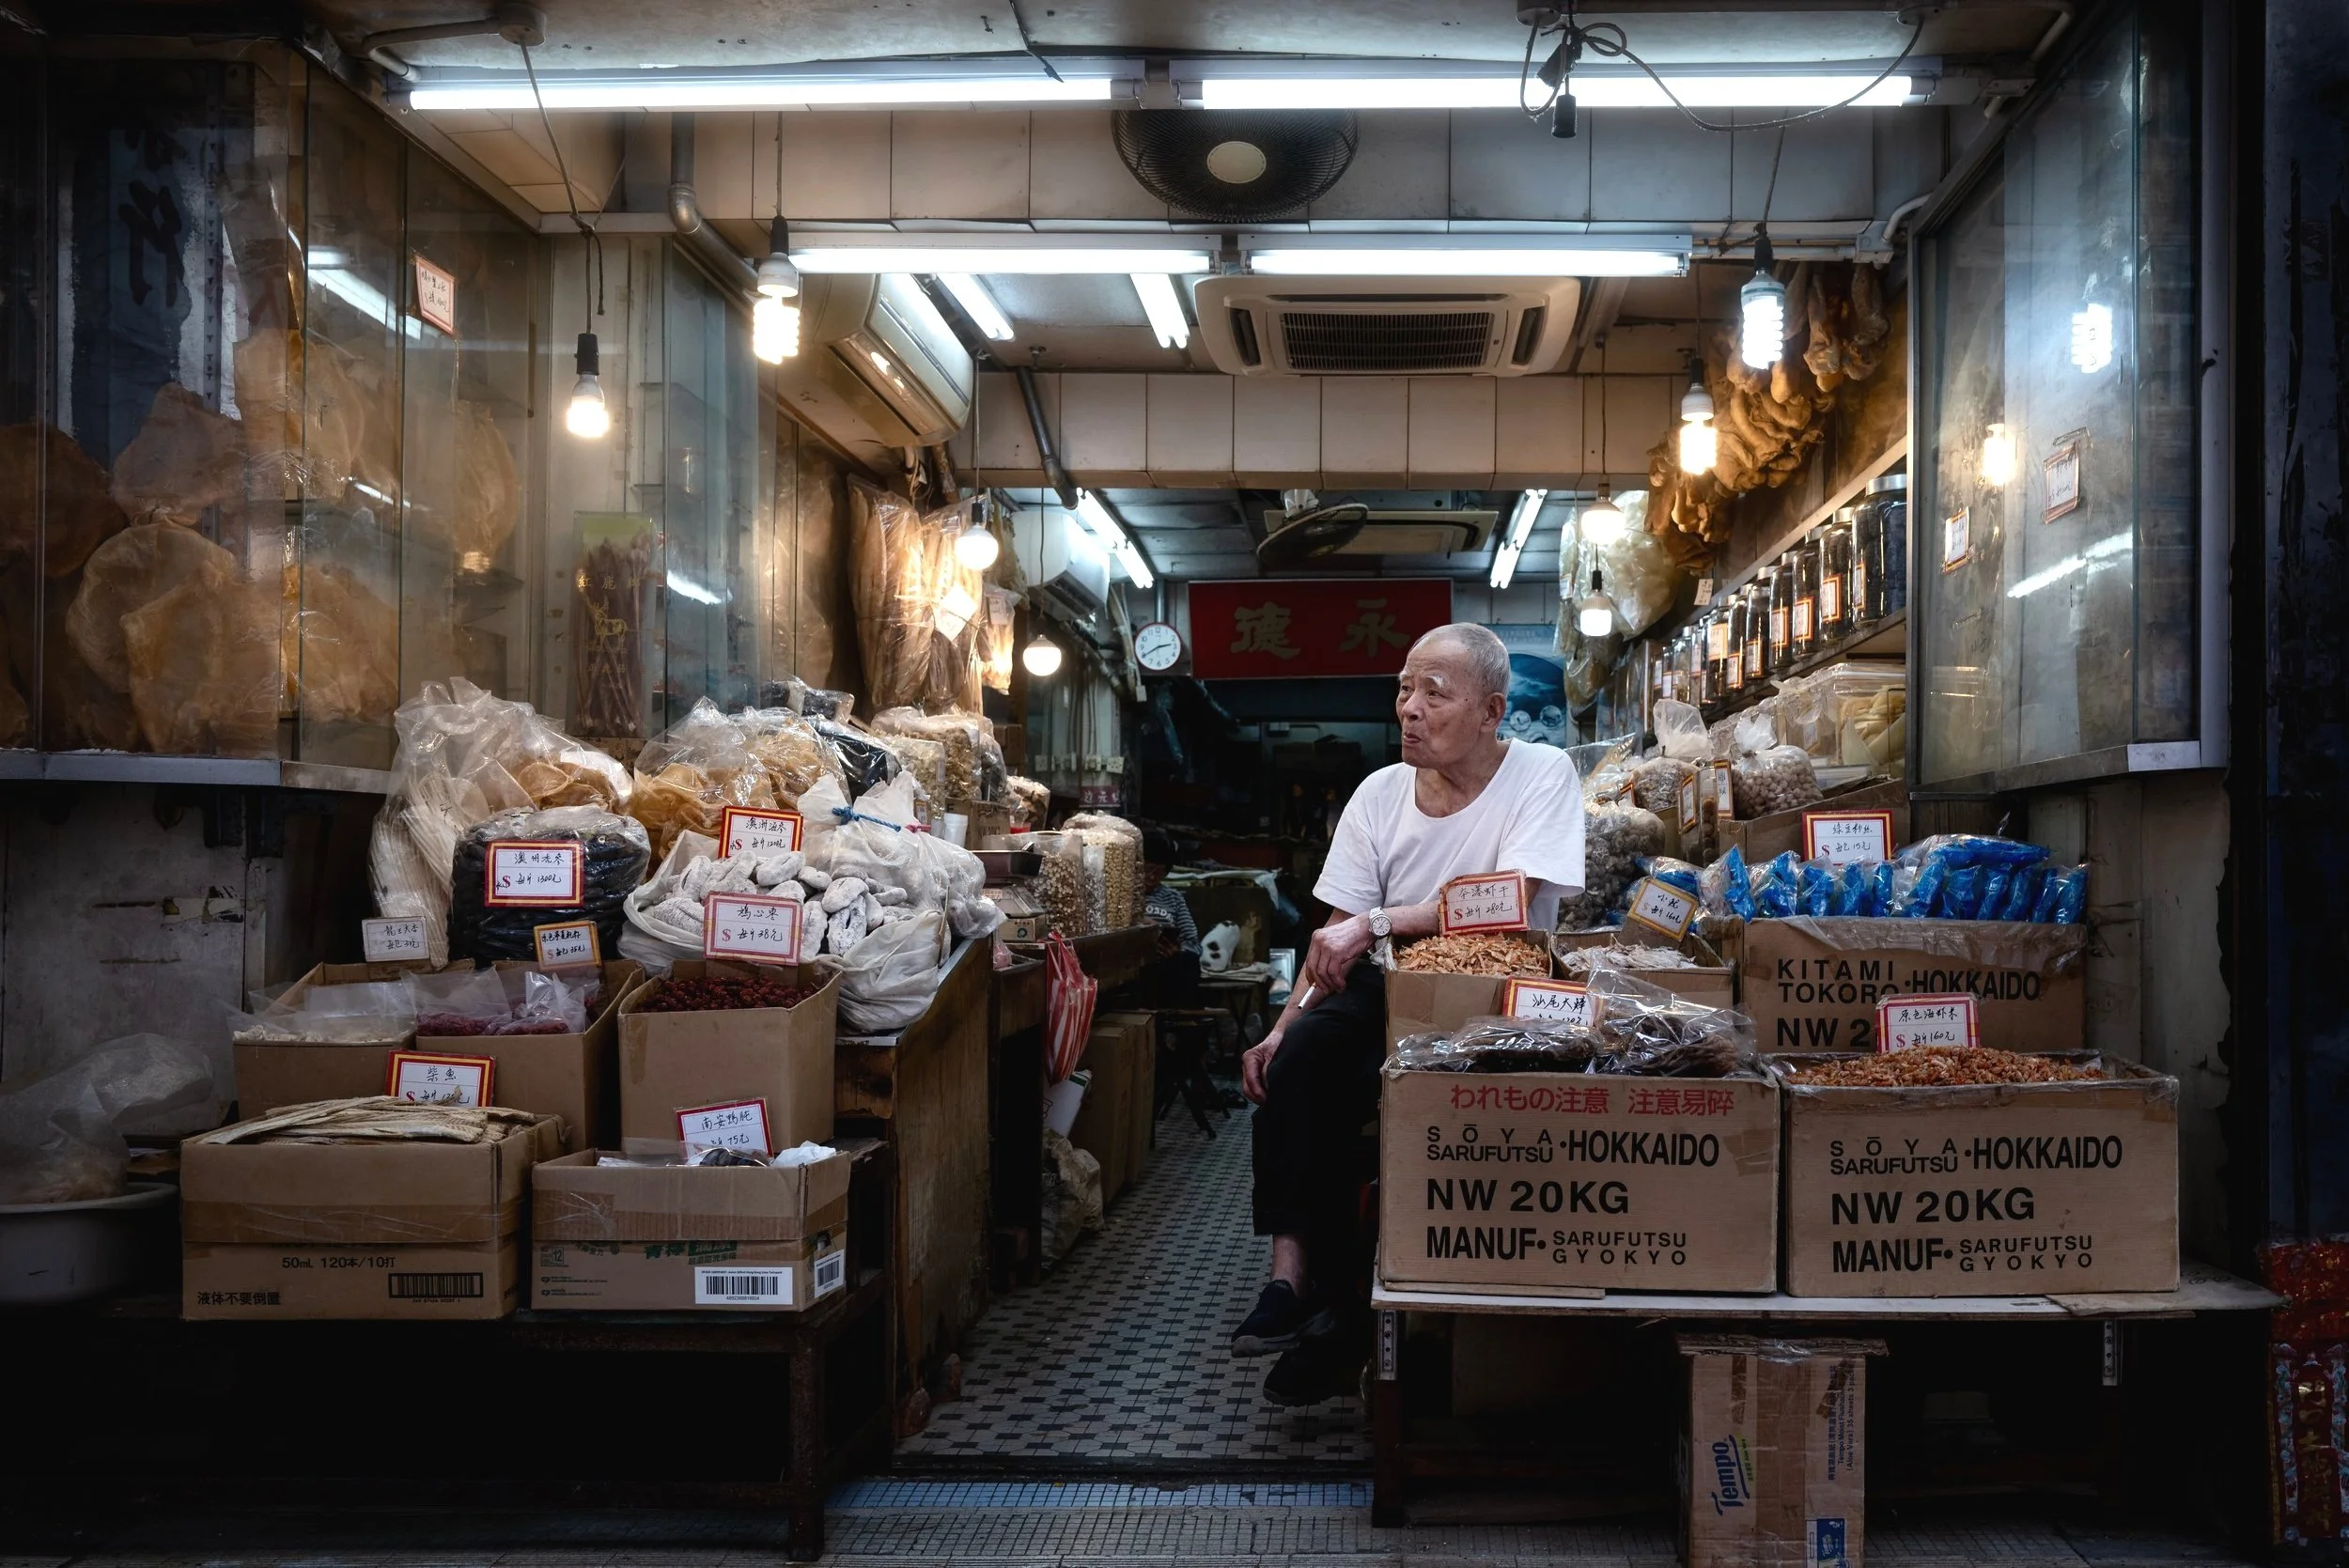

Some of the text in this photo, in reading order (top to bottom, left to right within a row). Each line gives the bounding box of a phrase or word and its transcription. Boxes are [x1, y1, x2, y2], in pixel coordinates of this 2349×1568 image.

[735, 839, 743, 850] $
[503, 875, 511, 889] $
[1454, 908, 1464, 922] $
[722, 928, 732, 942] $
[1778, 958, 1894, 981] KITAMI
[1777, 1017, 1846, 1048] NW
[1896, 1033, 1906, 1048] $
[1451, 1085, 1735, 1117] われもの注意 注意易碎
[1426, 1145, 1553, 1163] SARUFUTSU
[1829, 1157, 1958, 1175] SARUFUTSU
[1427, 1178, 1629, 1214] NW 20KG
[1831, 1187, 2034, 1224] NW 20KG
[1552, 1231, 1687, 1248] SARUFUTSU
[1959, 1235, 2092, 1254] SARUFUTSU
[552, 1248, 563, 1263] 12
[1552, 1249, 1687, 1265] GYOKYO
[1959, 1252, 2092, 1272] GYOKYO
[1711, 1441, 1745, 1516] Tempo
